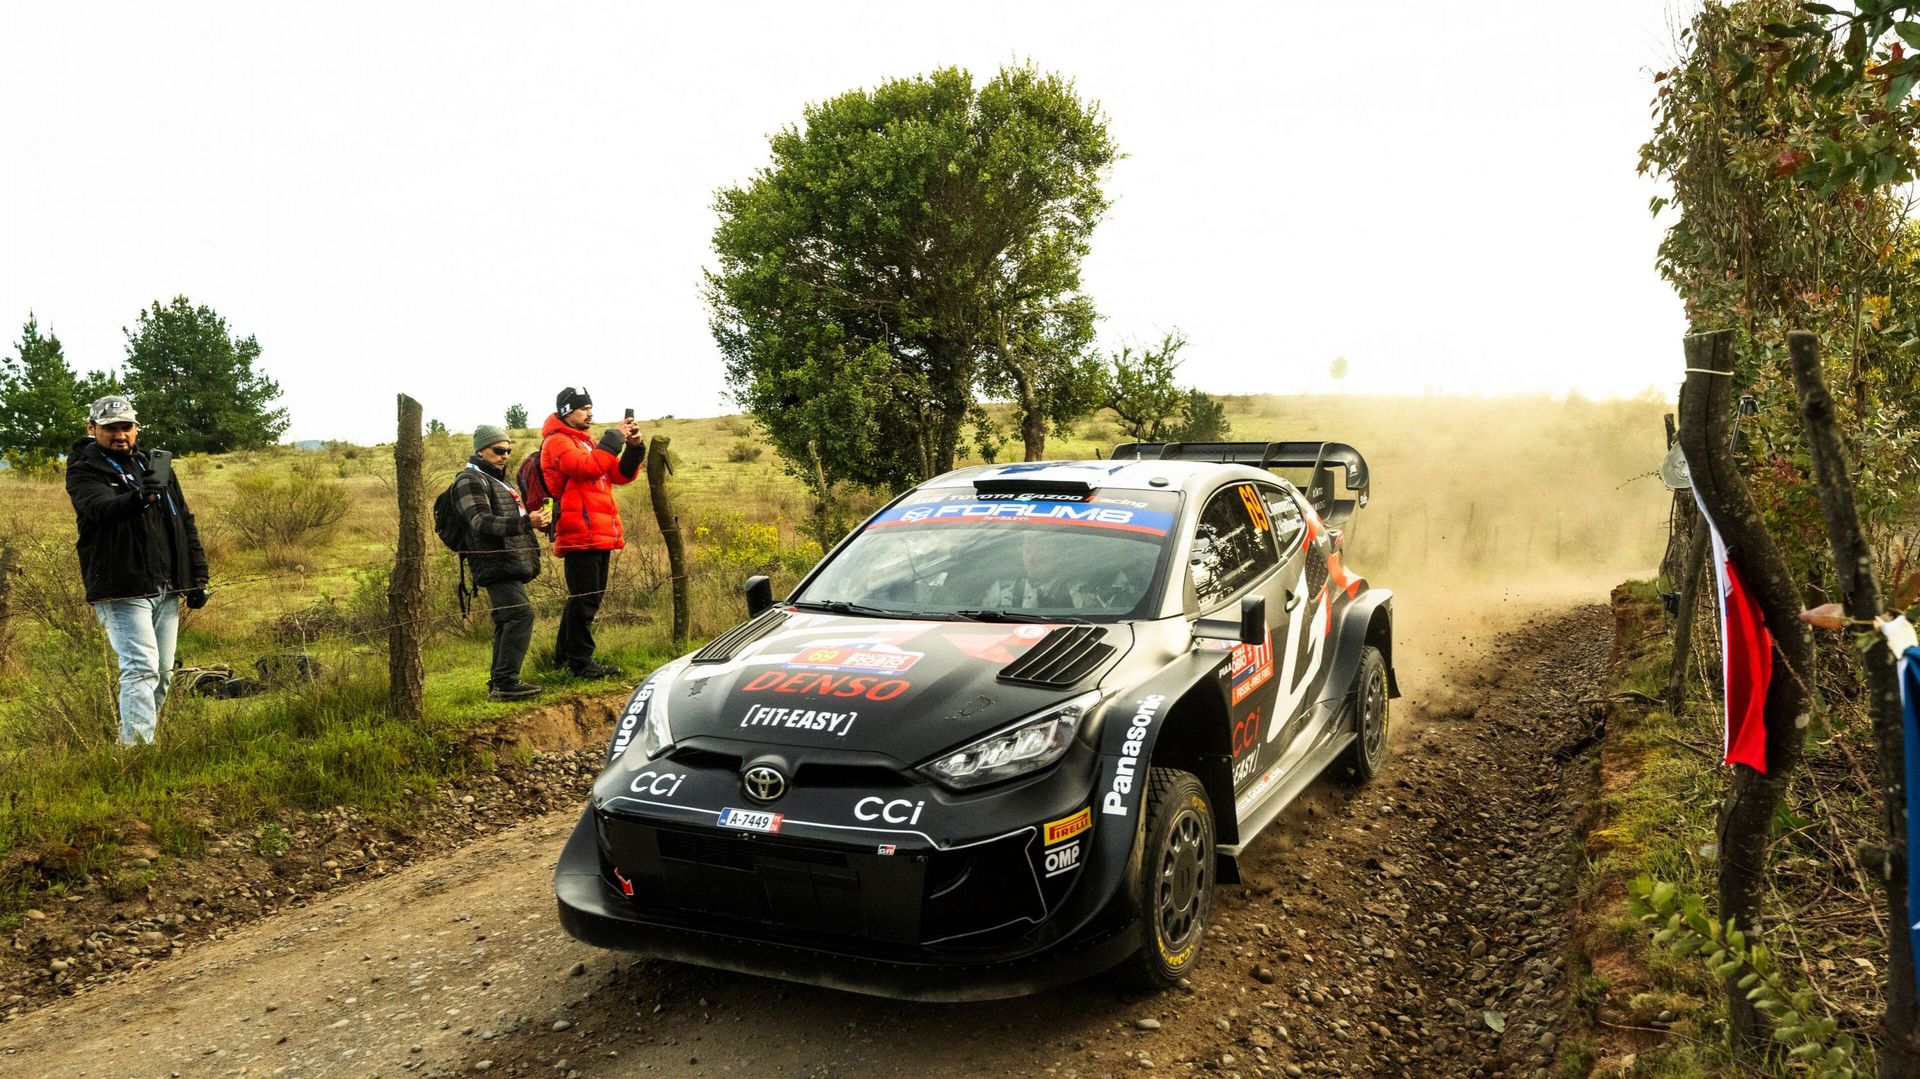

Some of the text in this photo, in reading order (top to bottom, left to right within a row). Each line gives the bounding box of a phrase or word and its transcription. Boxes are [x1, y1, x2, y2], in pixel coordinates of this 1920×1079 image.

[934, 503, 1133, 524] FORUM8
[950, 493, 1014, 501] TOYOTA
[1014, 492, 1084, 502] GAZOO
[1086, 495, 1149, 508] Racing
[1238, 484, 1269, 531] 69
[807, 649, 841, 662] 69
[741, 671, 911, 701] DENSO
[740, 704, 858, 736] [FIT-EASY]
[1102, 694, 1166, 816] Panasonic
[730, 812, 769, 828] A-7449
[1049, 812, 1088, 841] PIRELLI
[1045, 845, 1080, 872] OMP
